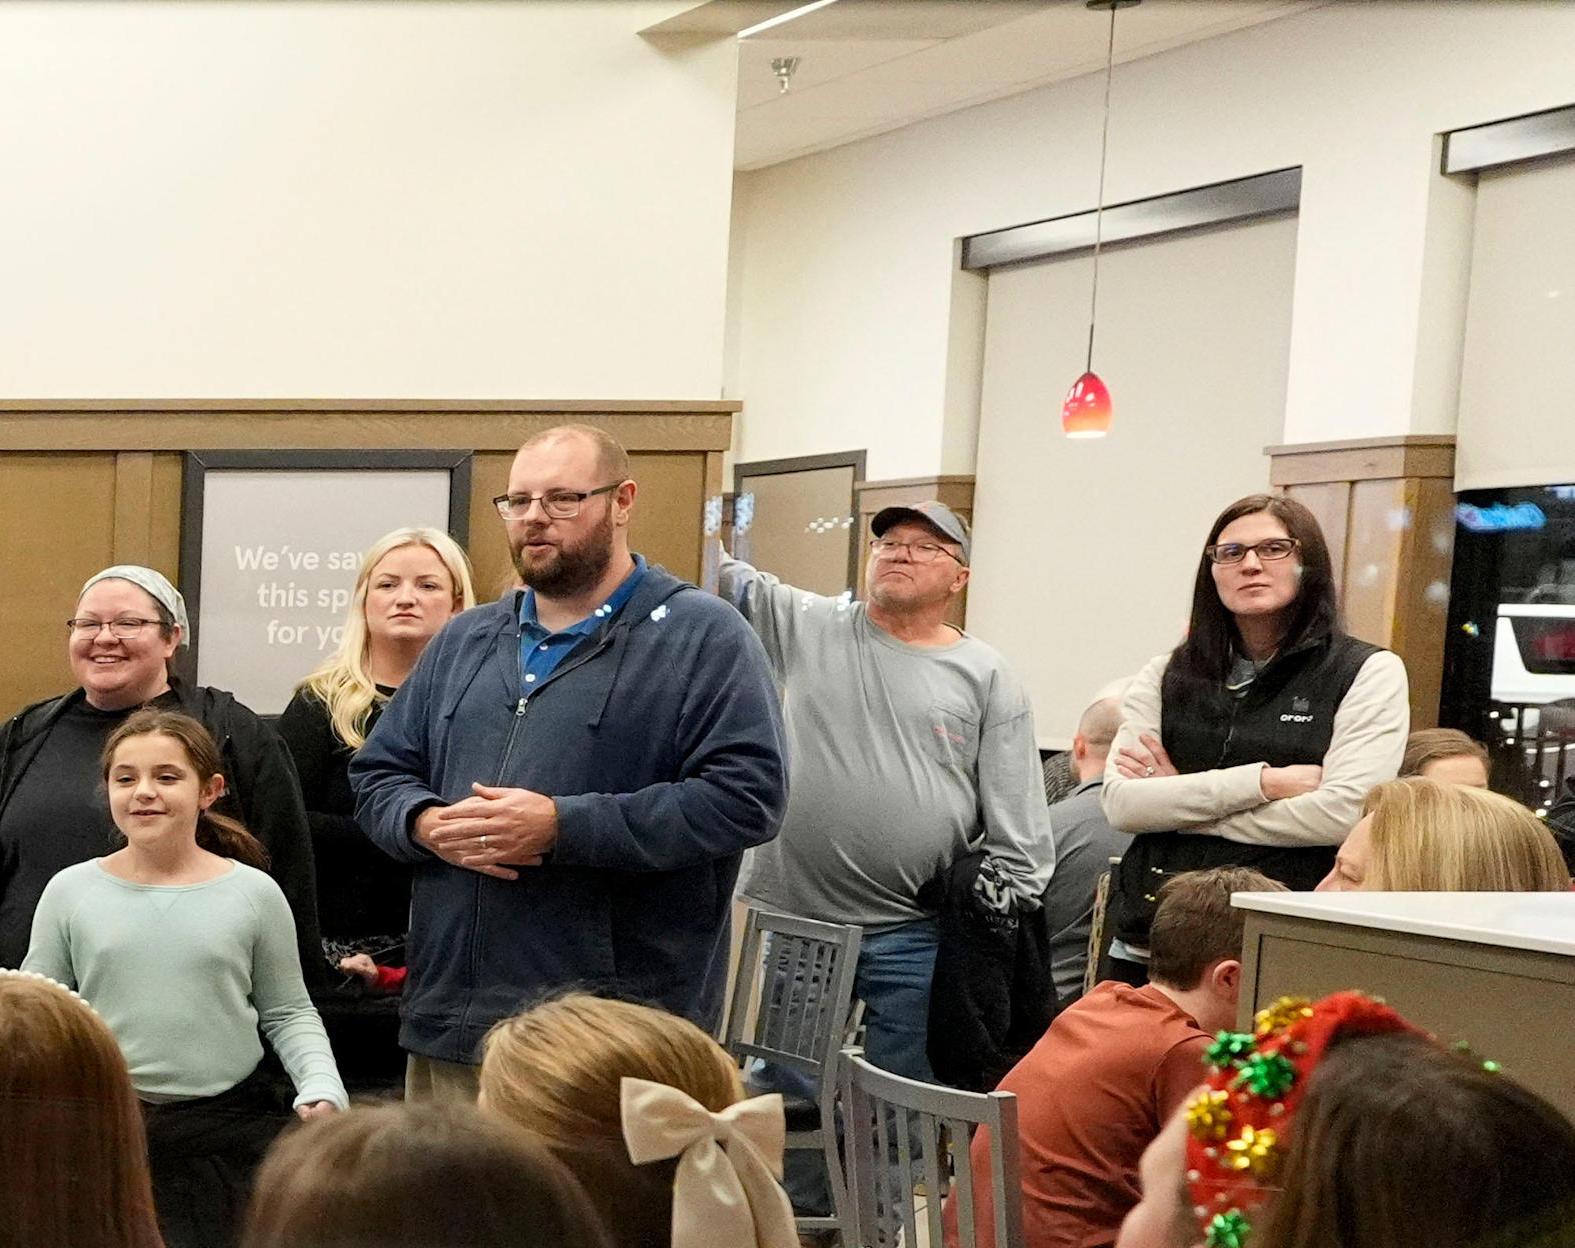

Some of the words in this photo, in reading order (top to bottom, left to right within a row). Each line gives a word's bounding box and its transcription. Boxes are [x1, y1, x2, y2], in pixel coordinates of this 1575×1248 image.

[234, 545, 320, 571] We've
[257, 582, 309, 608] this
[317, 588, 349, 614] sp
[267, 620, 309, 644] for
[316, 626, 346, 651] yo
